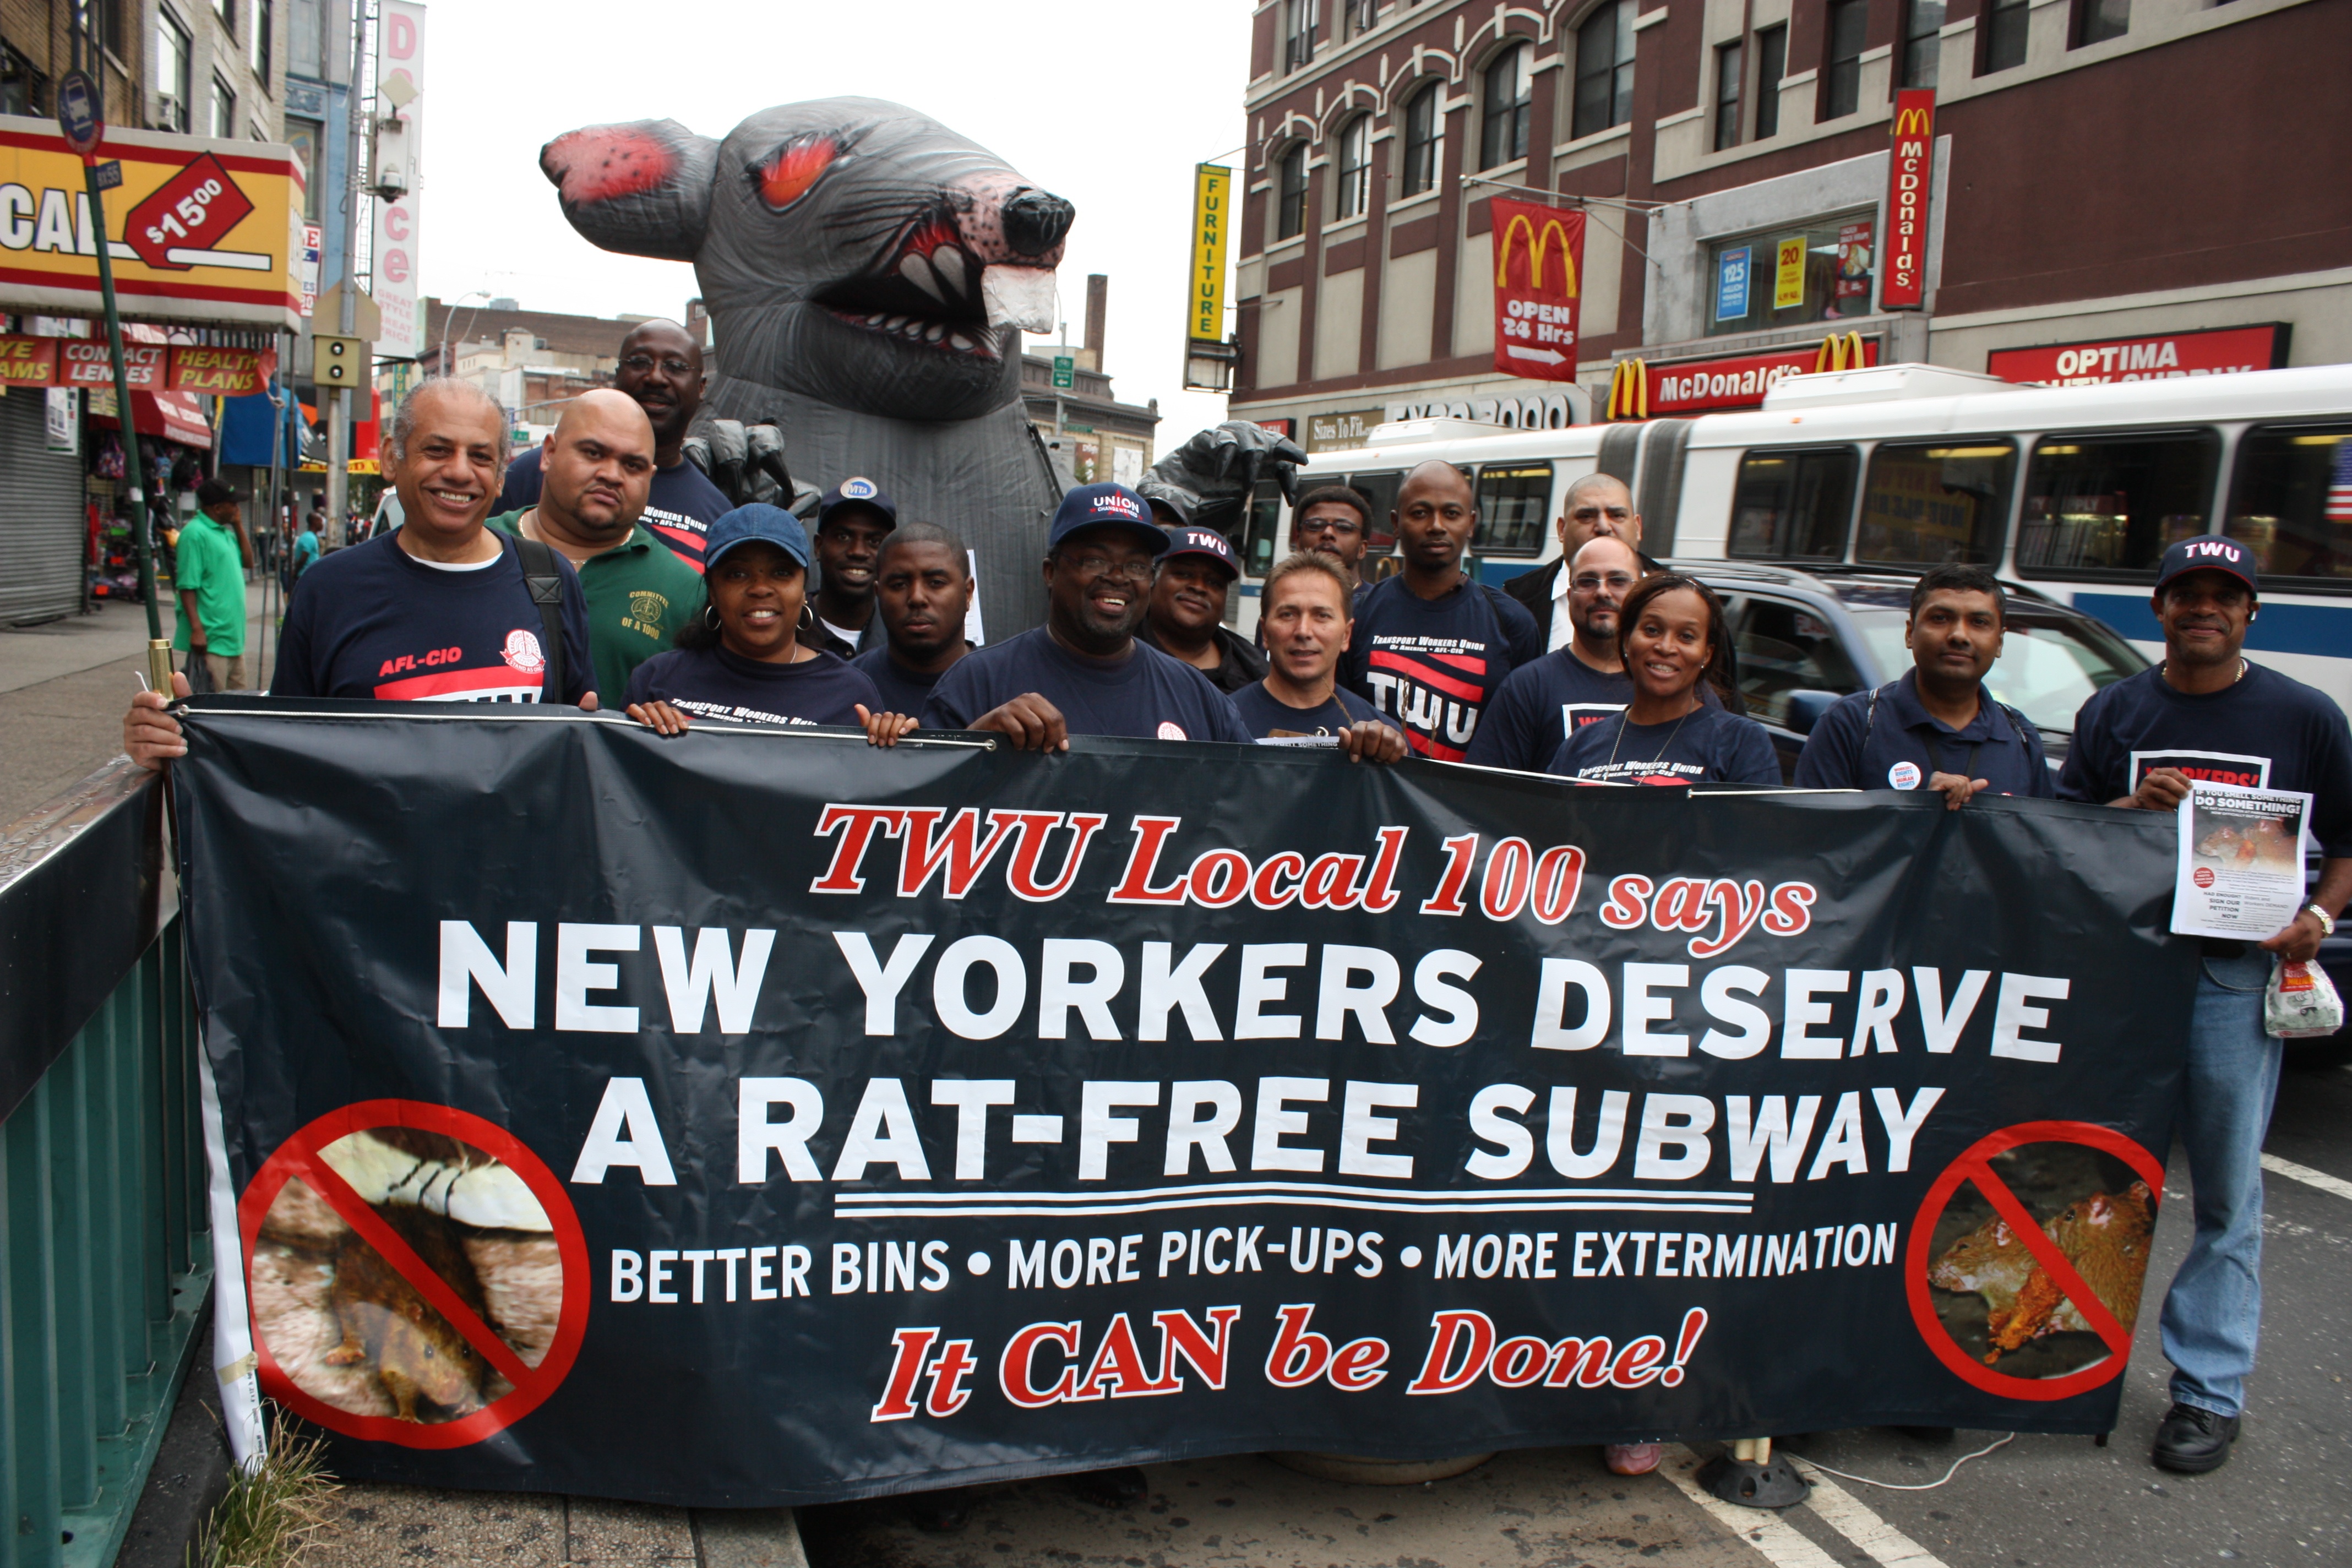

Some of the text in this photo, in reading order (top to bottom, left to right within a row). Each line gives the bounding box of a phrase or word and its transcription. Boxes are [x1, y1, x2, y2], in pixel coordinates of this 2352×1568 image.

[1896, 141, 1923, 287] McDonald's
[1200, 178, 1219, 333] FURNITURE
[1781, 246, 1799, 266] 20
[1507, 300, 1570, 324] OPEN
[1502, 317, 1574, 345] 24 Hrs
[66, 344, 162, 364] CONACT
[177, 350, 260, 370] HEALTH
[2056, 341, 2179, 377] OPTIMA
[0, 362, 51, 381] AMS
[70, 365, 154, 384] LENES
[178, 369, 257, 390] PLANS
[1314, 419, 1336, 440] Sizes
[1337, 417, 1349, 439] To
[848, 484, 868, 494] MTA
[1093, 496, 1139, 513] UNION
[644, 505, 707, 532] WORKERS UNION
[659, 519, 689, 530] AFL-CIO
[1187, 532, 1227, 556] TWU
[2184, 542, 2241, 563] TWU
[622, 617, 660, 640] OF A 1000
[1373, 635, 1485, 651] TRANSPORT WORKERS UNION
[378, 646, 462, 677] AFL-CIO
[510, 660, 526, 671] STAND
[671, 698, 732, 714] TRANSPORT
[733, 706, 788, 725] WORKERS
[706, 712, 744, 723] AMERICA
[1366, 671, 1478, 743] TWU
[1577, 760, 1704, 778] TRANSPORT WORKERS UNION
[2195, 796, 2301, 814] DO SOMETHING!
[2251, 793, 2301, 804] SOMETHING
[809, 803, 1817, 959] TWU Local 100 says
[438, 920, 2071, 1063] NEW YORKERS DESERVE
[570, 1076, 1946, 1186] A RAT-FREE SUBWAY
[611, 1221, 1897, 1304] BETTER BINS MORE PICK-UPS MORE EXTERMINATION
[870, 1303, 1708, 1423] It CAN be Done!
